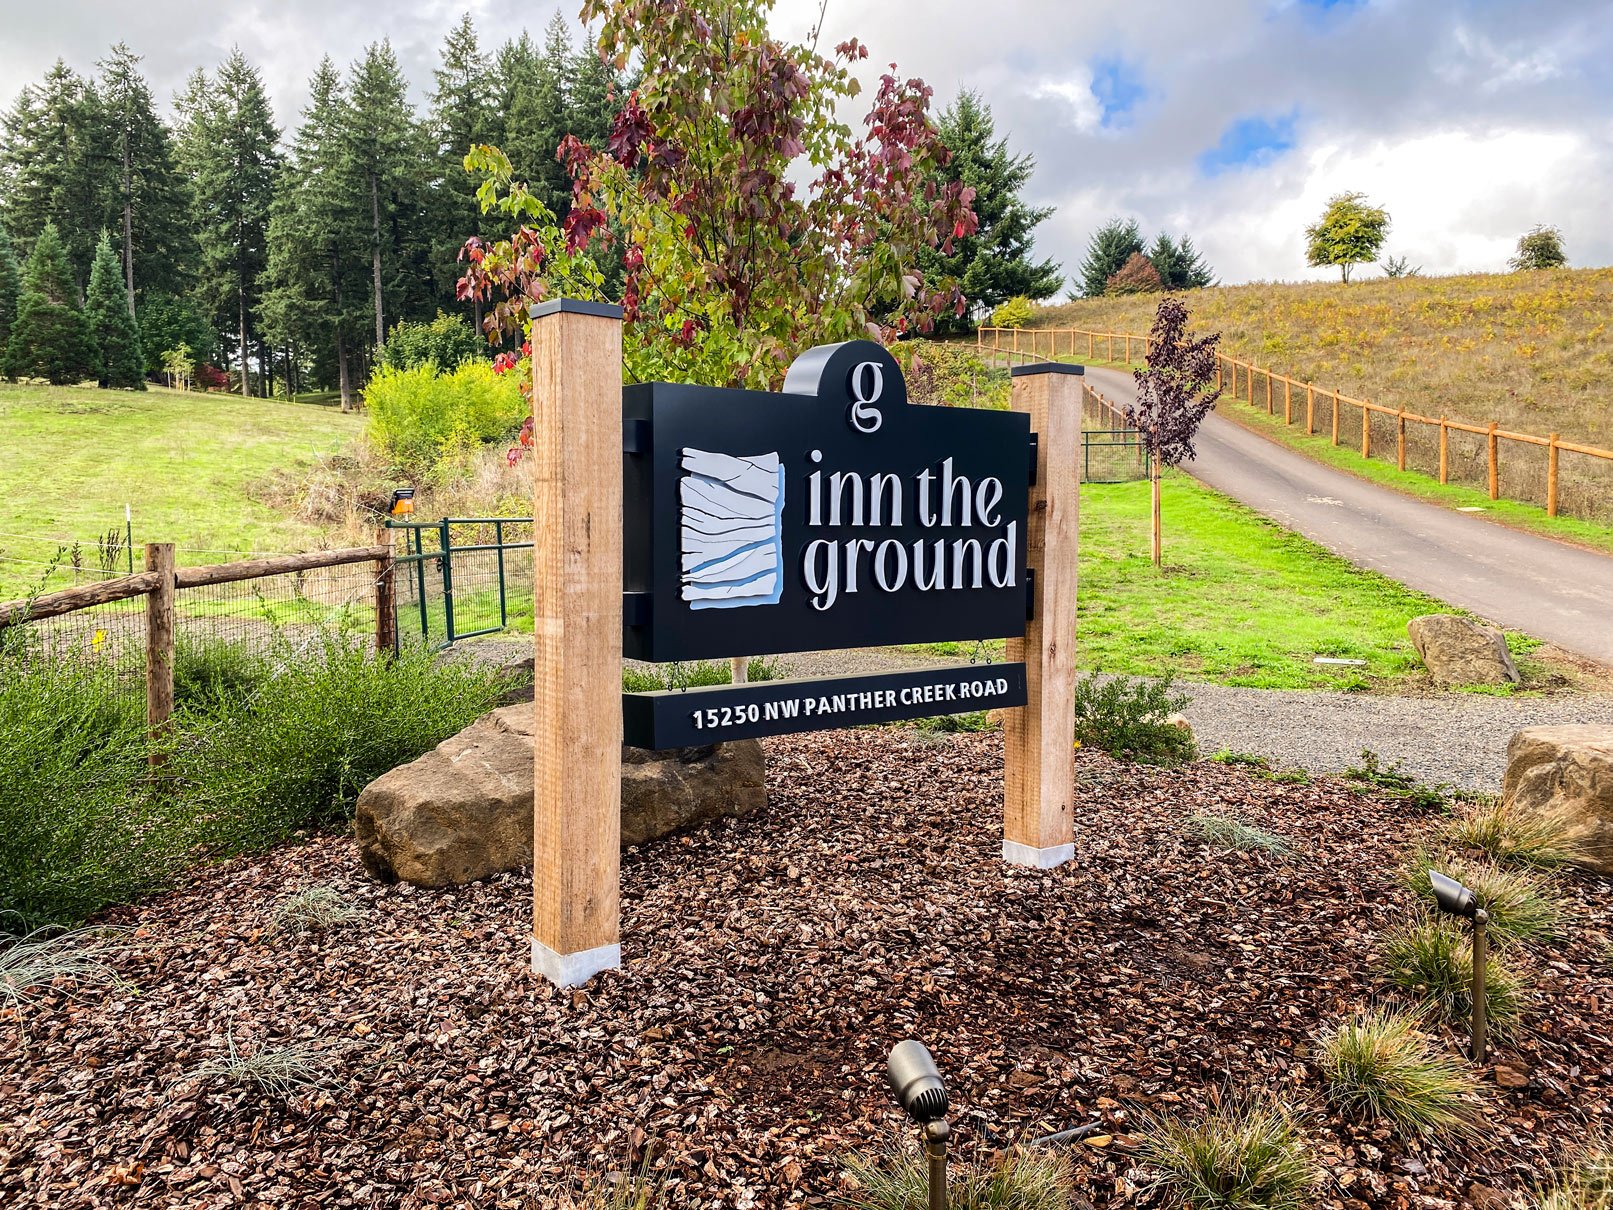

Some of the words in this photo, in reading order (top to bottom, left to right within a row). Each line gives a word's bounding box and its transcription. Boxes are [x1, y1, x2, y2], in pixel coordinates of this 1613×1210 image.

[851, 361, 883, 433] g
[809, 449, 903, 527] inn
[916, 456, 1003, 527] the
[803, 520, 1017, 611] ground
[693, 704, 760, 729] 15250
[764, 699, 800, 721] NW
[805, 690, 897, 716] PANTHER
[900, 683, 956, 706] CREEK
[960, 678, 1008, 699] ROAD
